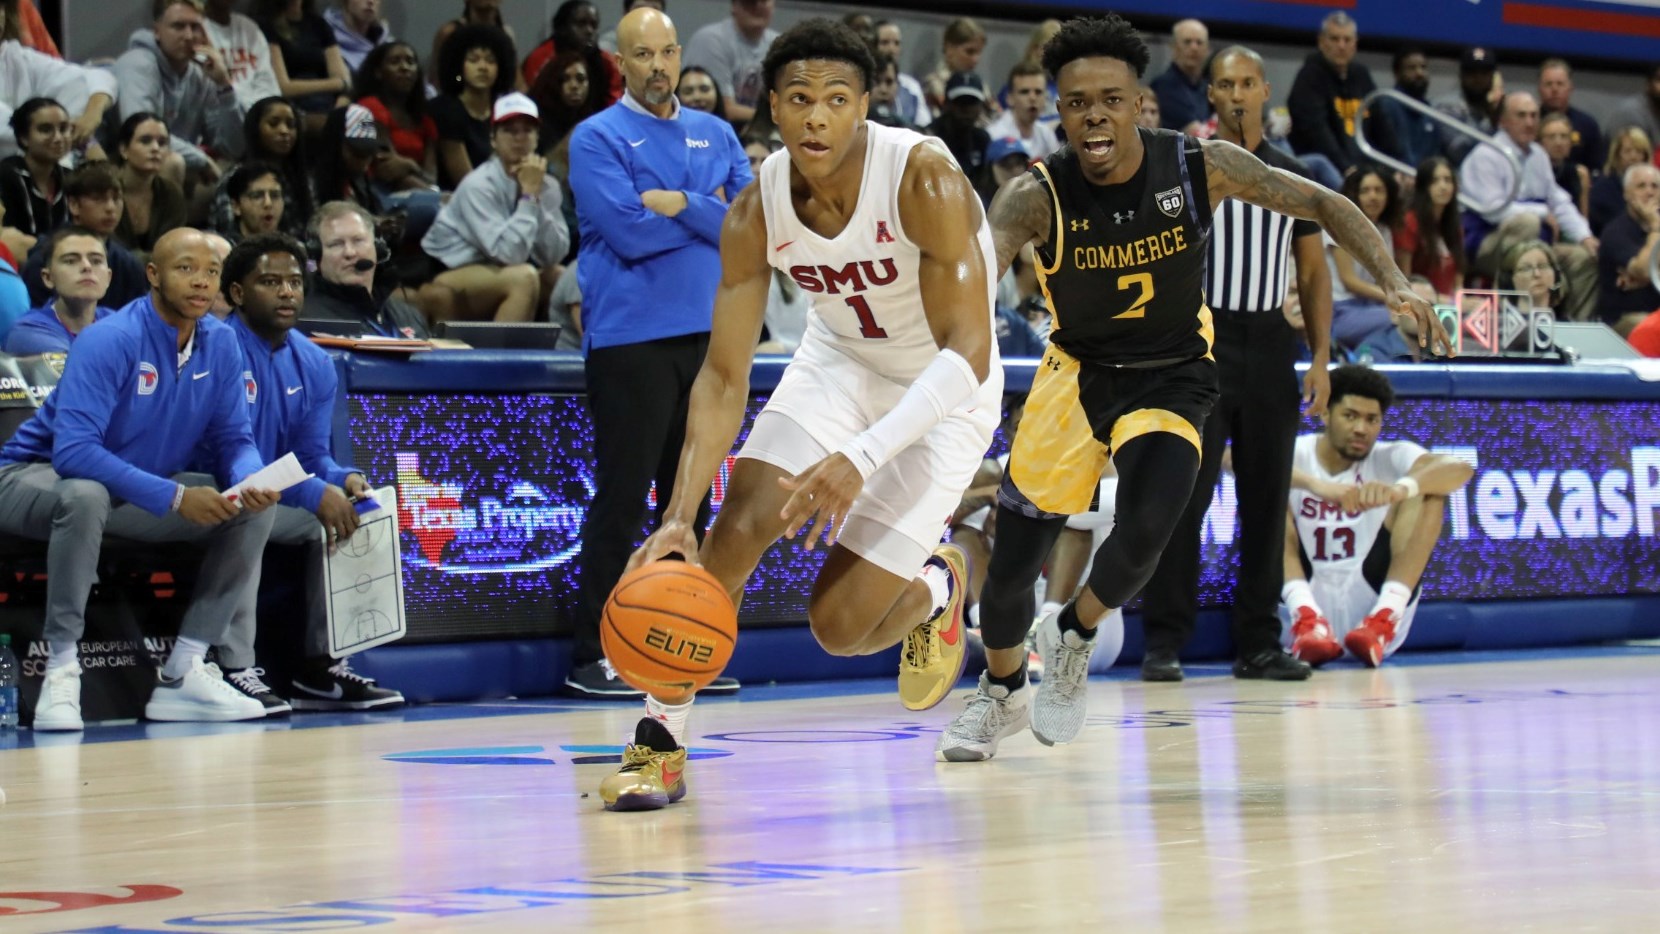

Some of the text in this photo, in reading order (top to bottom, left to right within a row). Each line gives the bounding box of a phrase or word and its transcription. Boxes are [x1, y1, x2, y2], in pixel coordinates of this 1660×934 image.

[1162, 196, 1181, 211] 60
[1074, 225, 1188, 270] COMMERCE
[789, 257, 899, 295] SMU
[1111, 272, 1155, 319] 2
[844, 294, 888, 339] 1
[1312, 526, 1356, 561] 13
[81, 640, 138, 655] EUROPEAN
[83, 655, 136, 668] CAR CARE
[645, 626, 714, 664] ELITE
